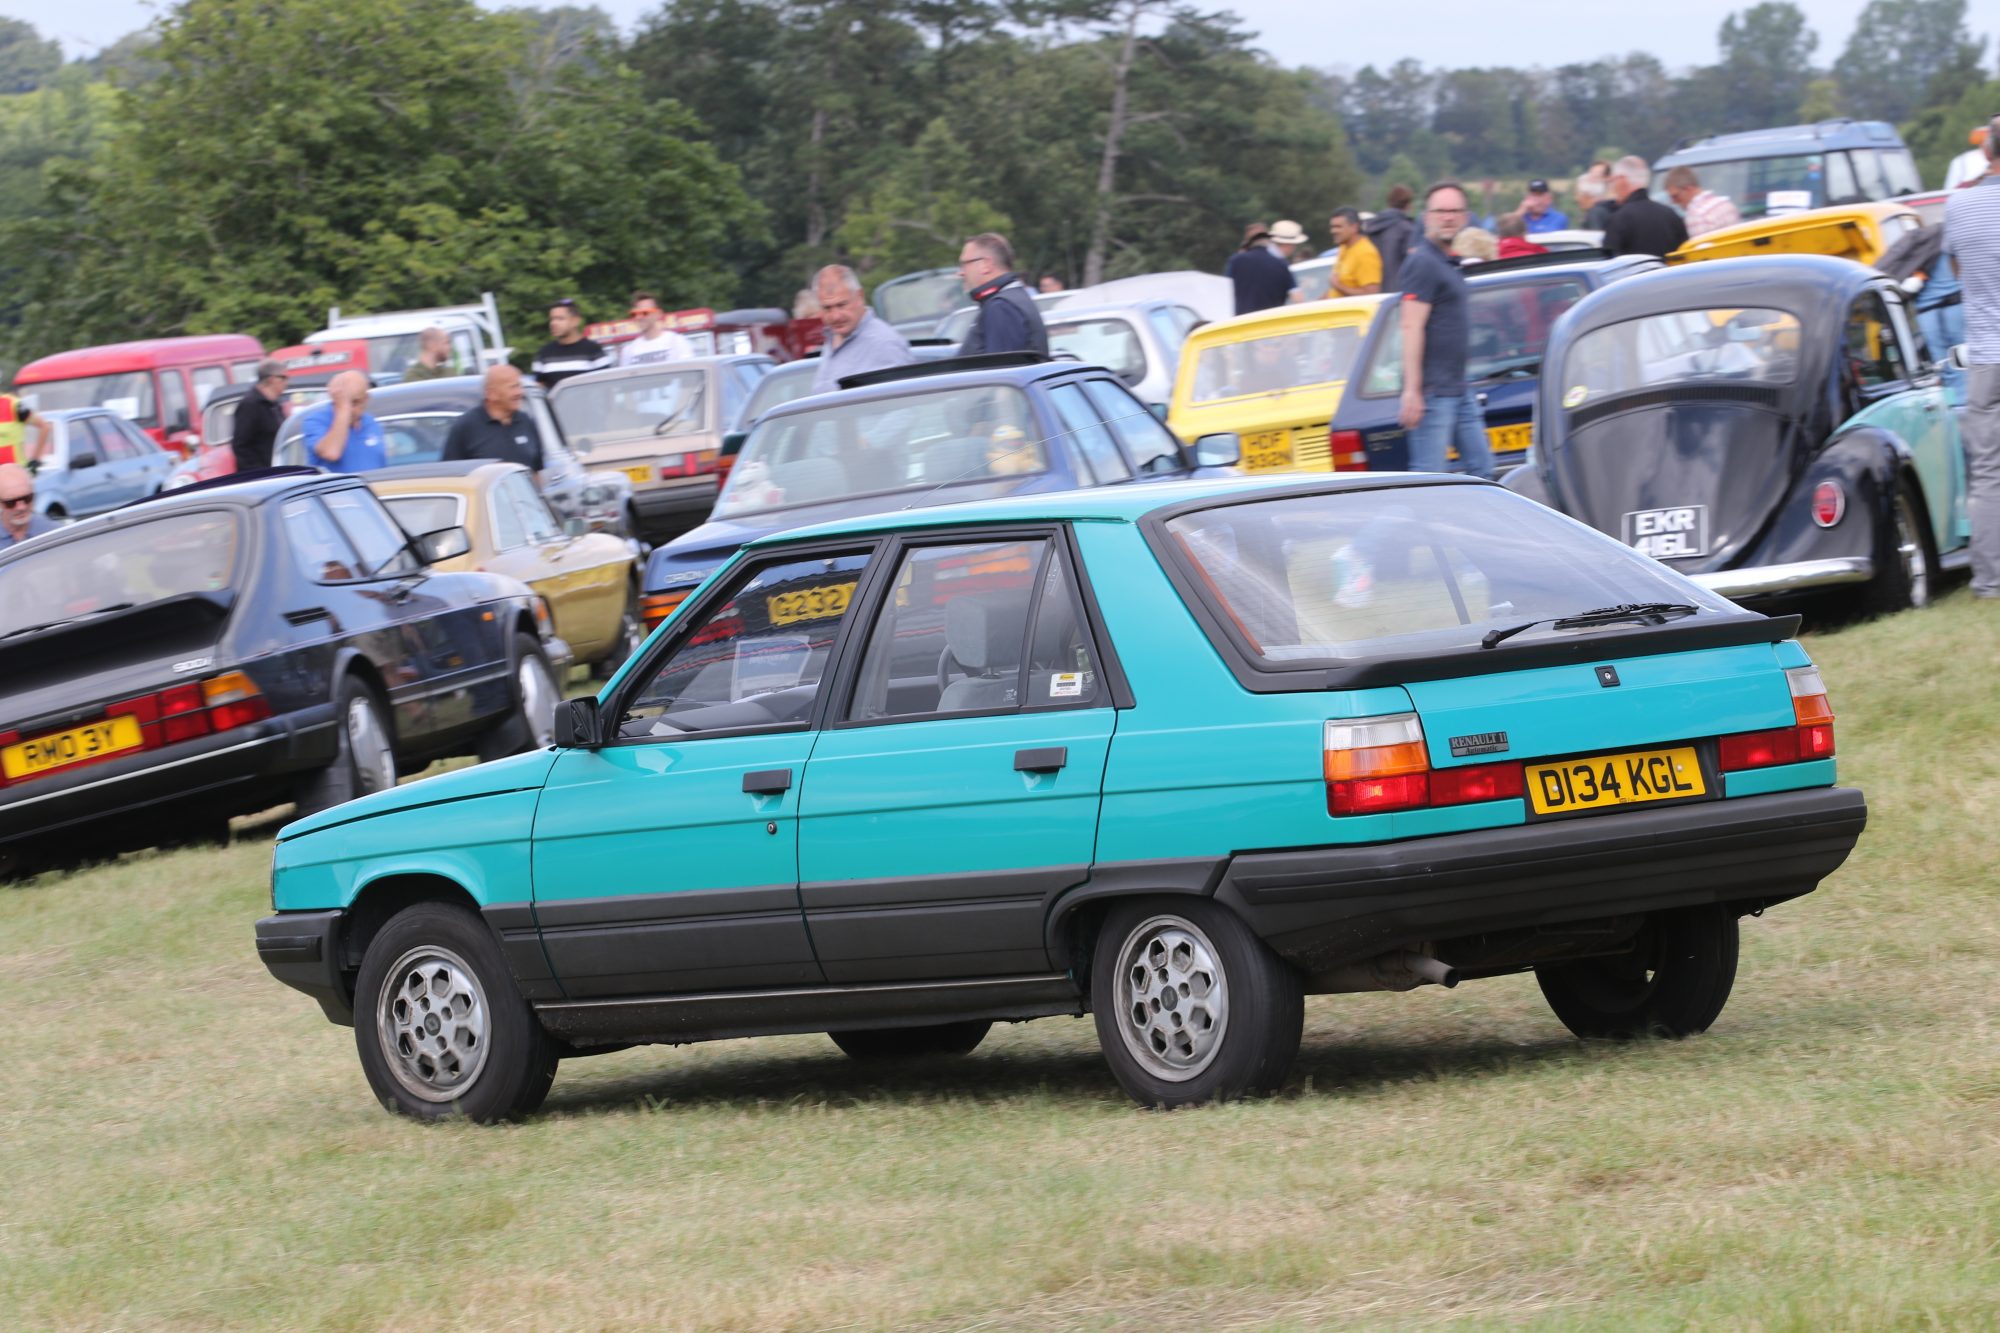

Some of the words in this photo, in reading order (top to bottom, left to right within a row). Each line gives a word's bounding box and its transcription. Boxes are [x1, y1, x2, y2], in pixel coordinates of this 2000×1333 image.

[1636, 509, 1696, 535] EKR
[83, 723, 115, 752] 3Y
[1451, 733, 1496, 748] RENAULT
[1538, 762, 1621, 807] D134
[1626, 755, 1692, 796] KGL
